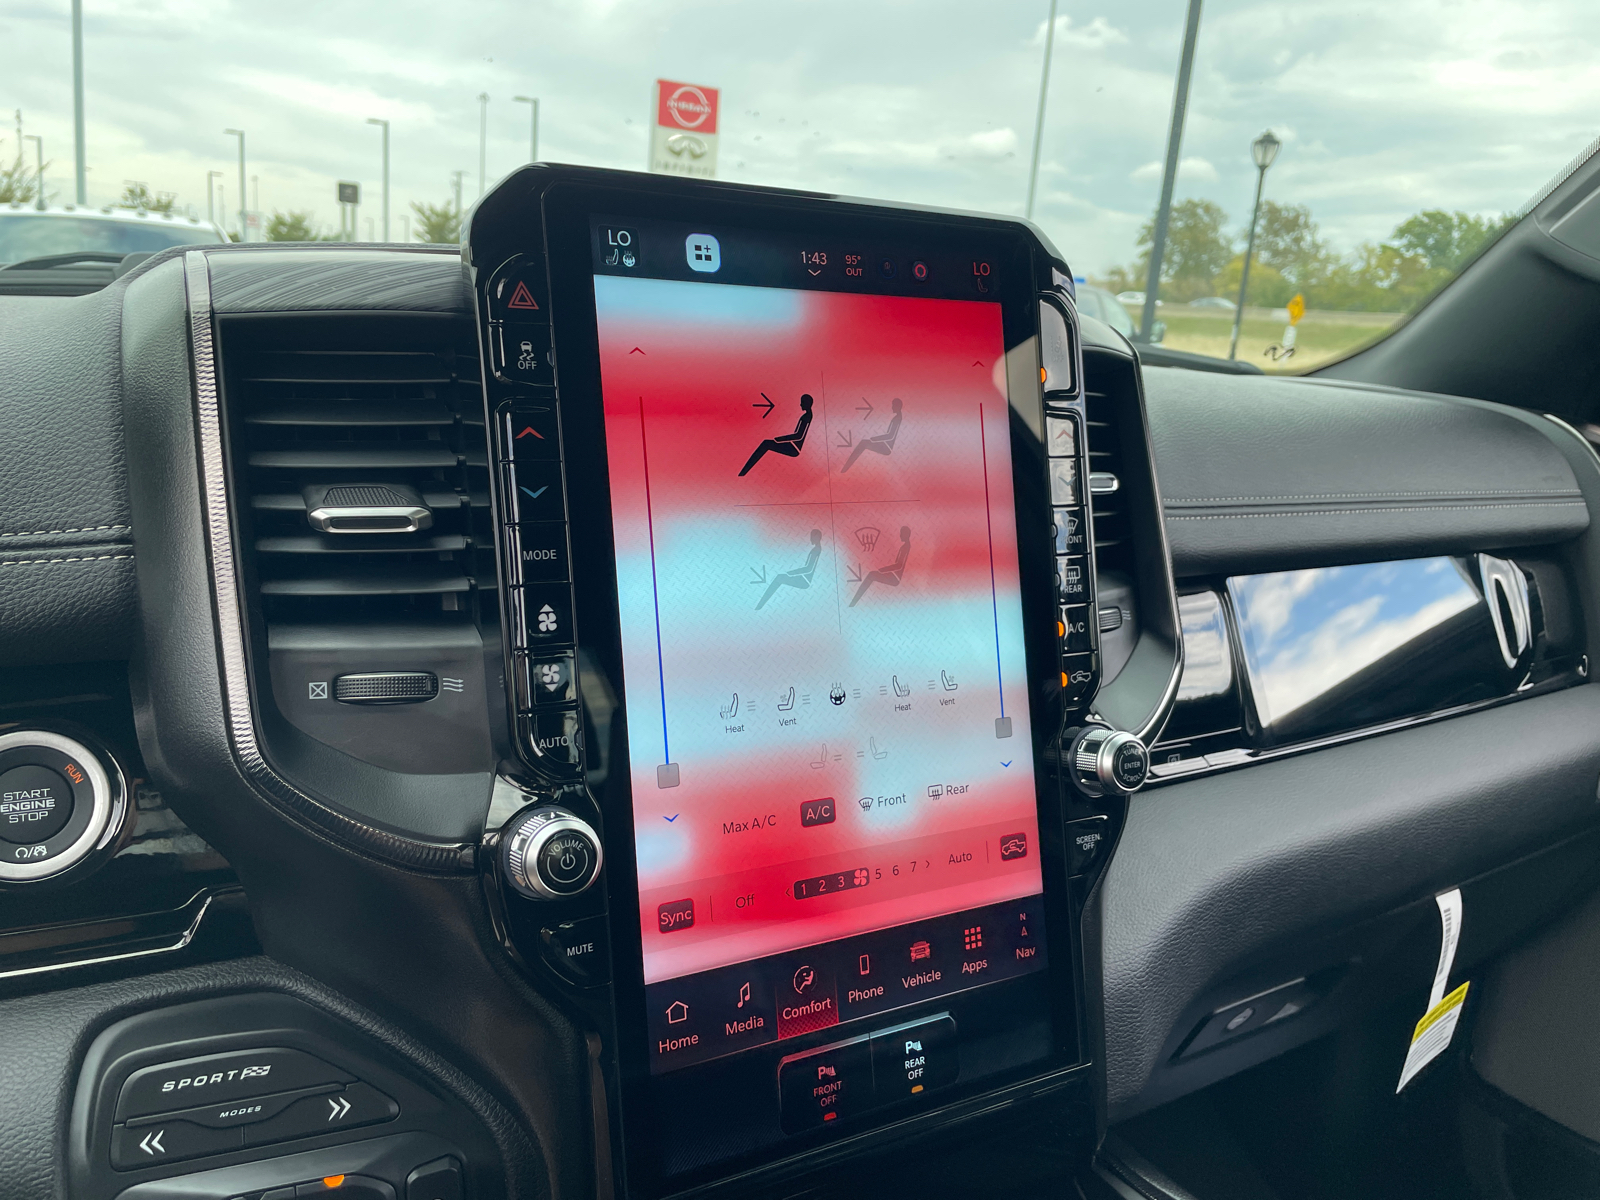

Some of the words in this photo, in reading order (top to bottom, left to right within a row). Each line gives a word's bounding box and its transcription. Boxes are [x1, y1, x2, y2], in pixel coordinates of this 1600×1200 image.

[608, 229, 631, 247] LO
[800, 250, 828, 267] 1:43
[845, 254, 862, 265] 95°
[845, 267, 863, 277] OUT
[973, 261, 991, 276] LO
[517, 360, 538, 370] OFF
[523, 549, 557, 561] MODE
[1064, 584, 1083, 593] REAR
[1068, 621, 1085, 633] A/C
[894, 702, 912, 712] Heat
[939, 697, 956, 707] Vent
[725, 723, 745, 734] Heat
[778, 716, 797, 727] Vent
[539, 735, 569, 750] AUTO
[1124, 761, 1141, 769] ENTER
[64, 763, 84, 784] RUN
[1123, 772, 1143, 782] SCROLL
[3, 788, 51, 800] START
[946, 782, 970, 796] Rear
[0, 798, 55, 812] ENGINE
[877, 792, 907, 808] Front
[8, 810, 49, 824] STOP
[806, 804, 831, 820] A/C
[722, 819, 750, 834] Max
[751, 814, 777, 830] A/C
[1075, 833, 1100, 845] SCREEN
[1082, 841, 1095, 851] OFF
[548, 839, 585, 857] VOLUME
[948, 850, 973, 865] Auto
[801, 883, 807, 896] 1
[818, 879, 826, 892] 2
[837, 876, 845, 888] 3
[875, 868, 882, 880] 5
[892, 864, 899, 876] 6
[910, 861, 917, 873] 7
[735, 893, 756, 908] Off
[660, 908, 692, 927] Sync
[566, 942, 594, 957] MUTE
[1015, 945, 1036, 960] Nav
[961, 957, 988, 975] Apps
[902, 968, 942, 989] Vehicle
[848, 984, 884, 1004] Phone
[782, 997, 832, 1021] Comfort
[725, 1015, 764, 1036] Media
[658, 1033, 699, 1054] Home
[904, 1055, 925, 1070] REAR
[161, 1069, 239, 1092] SPORT
[907, 1068, 924, 1080] OFF
[813, 1080, 842, 1097] FRONT
[820, 1094, 837, 1107] OFF
[219, 1105, 262, 1118] MODES
